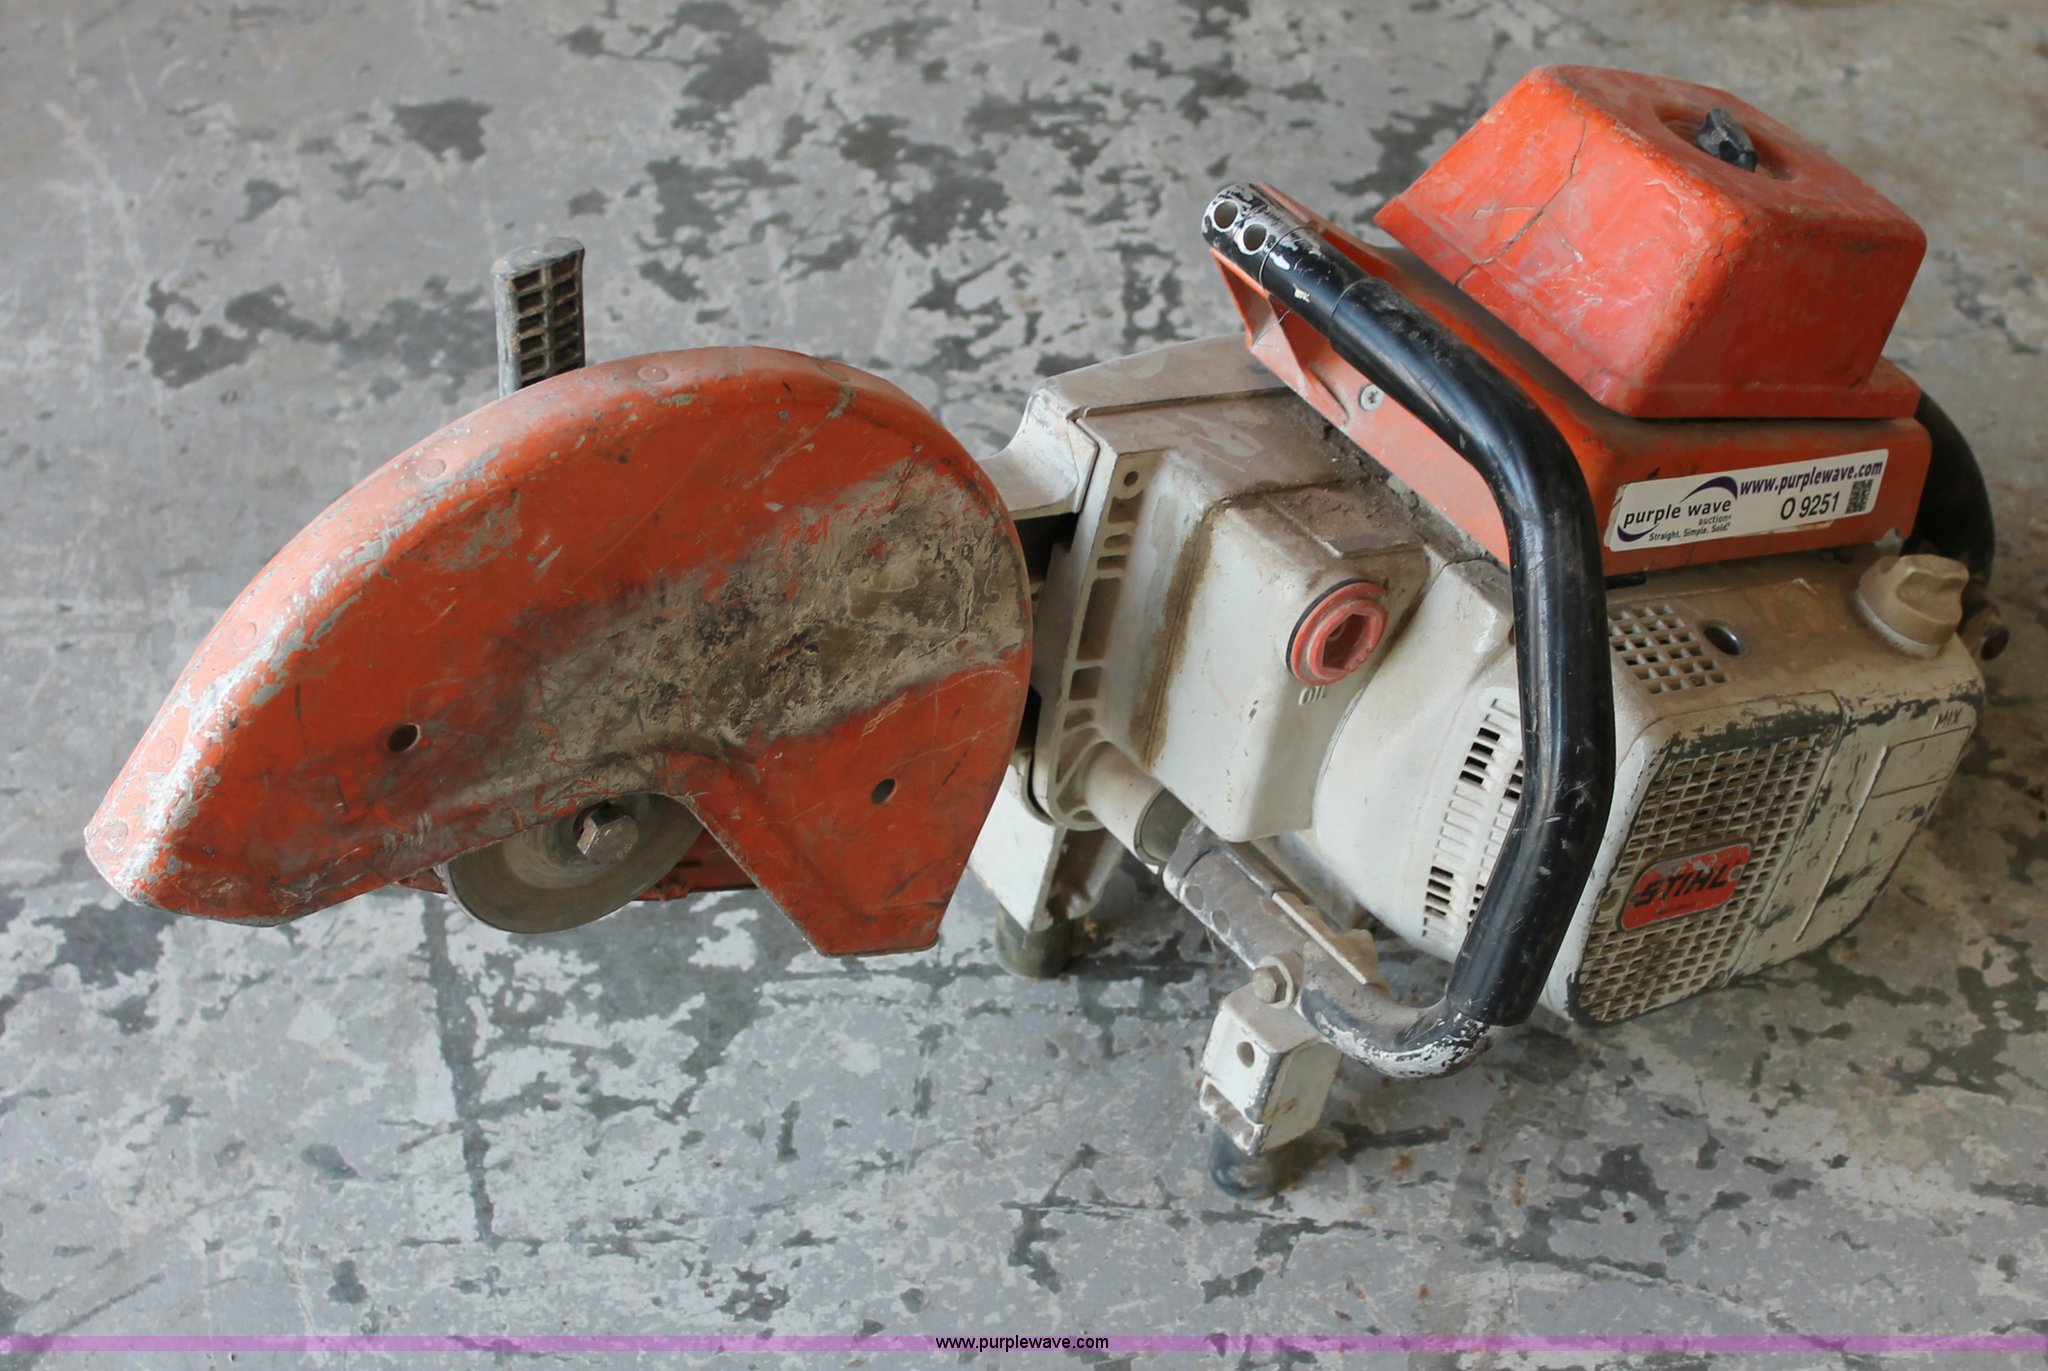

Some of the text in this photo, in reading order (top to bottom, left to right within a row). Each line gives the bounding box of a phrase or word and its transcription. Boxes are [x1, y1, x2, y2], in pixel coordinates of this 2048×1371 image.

[1740, 461, 1883, 497] www.purplewave.com
[1623, 499, 1731, 528] purple wave
[1799, 491, 1840, 518] 9251
[1298, 684, 1325, 705] OIL
[1631, 864, 1729, 907] STIHL
